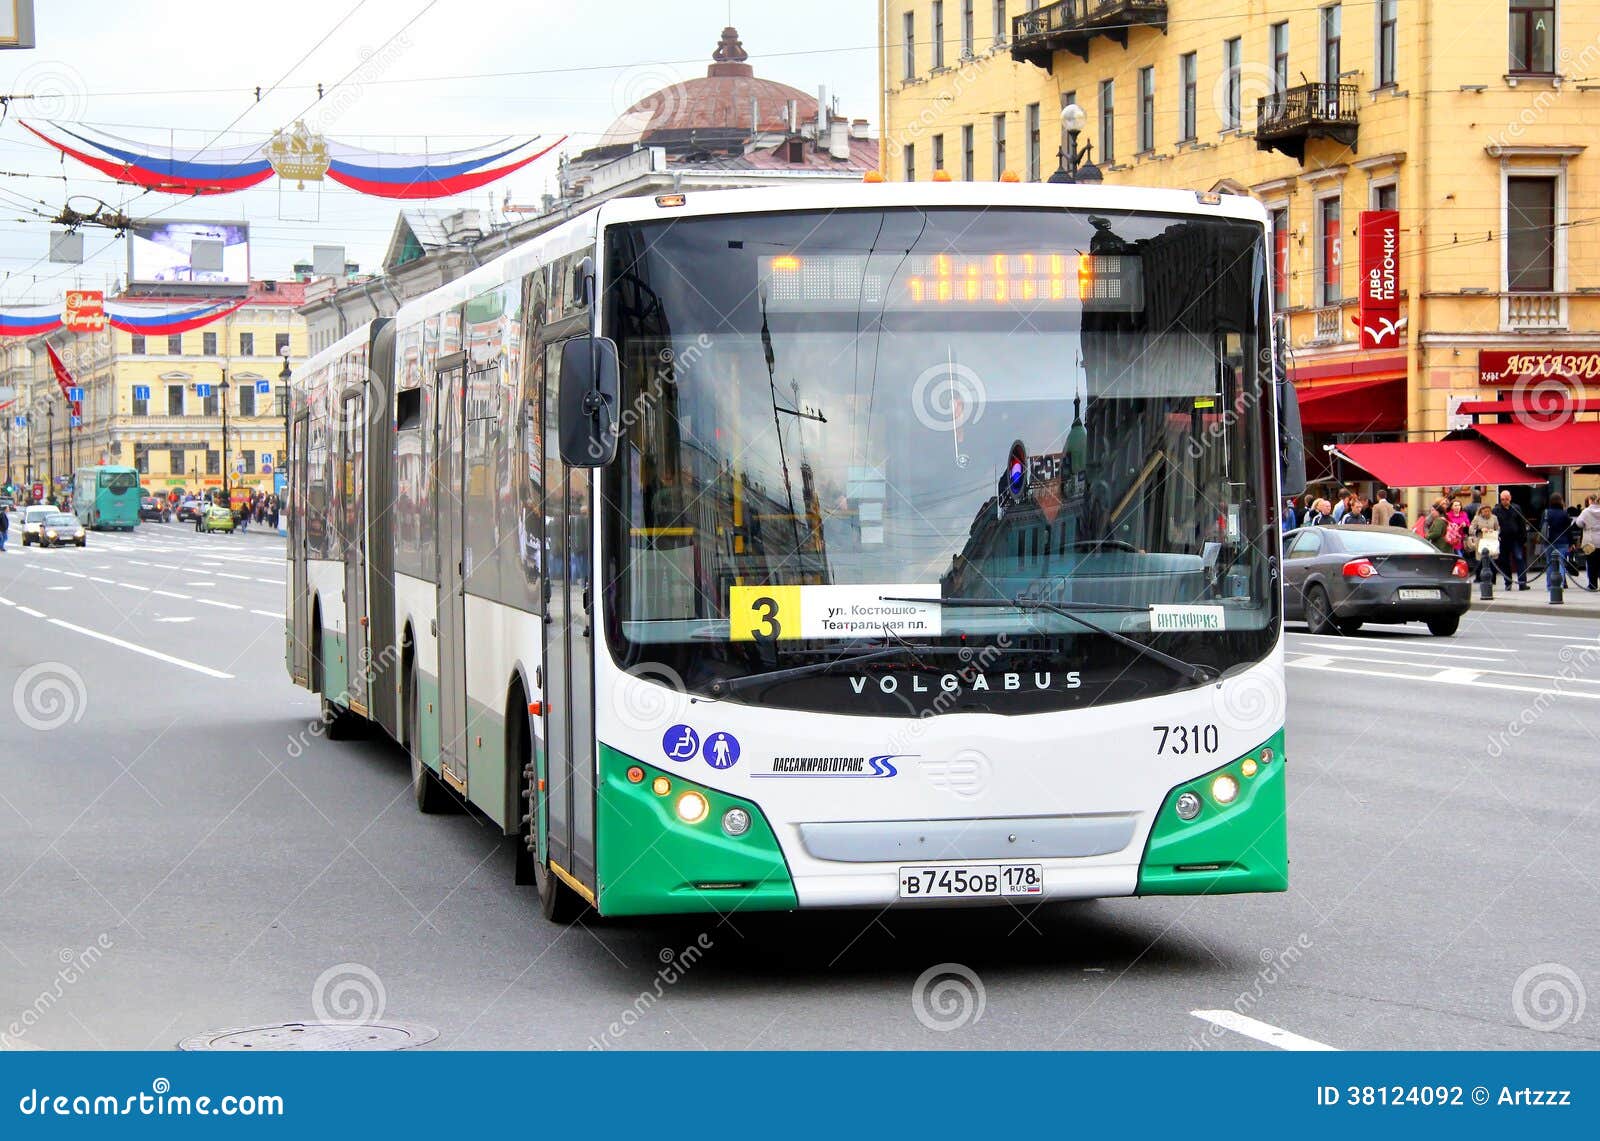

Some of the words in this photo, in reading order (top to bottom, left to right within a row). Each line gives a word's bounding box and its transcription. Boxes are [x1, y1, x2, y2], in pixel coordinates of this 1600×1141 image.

[1383, 228, 1395, 300] палочки
[1370, 268, 1383, 300] две
[1500, 354, 1600, 378] АБХАЗИ
[751, 597, 781, 642] 3
[828, 607, 847, 617] ул.
[851, 605, 916, 615] Костюшко
[821, 619, 904, 631] Театральная
[908, 621, 928, 629] пл.
[849, 671, 1082, 694] VOLGABUS
[1153, 724, 1218, 755] 7310
[772, 757, 864, 772] ПАССАЖИРАВТОТРАНС
[1003, 867, 1036, 885] 178
